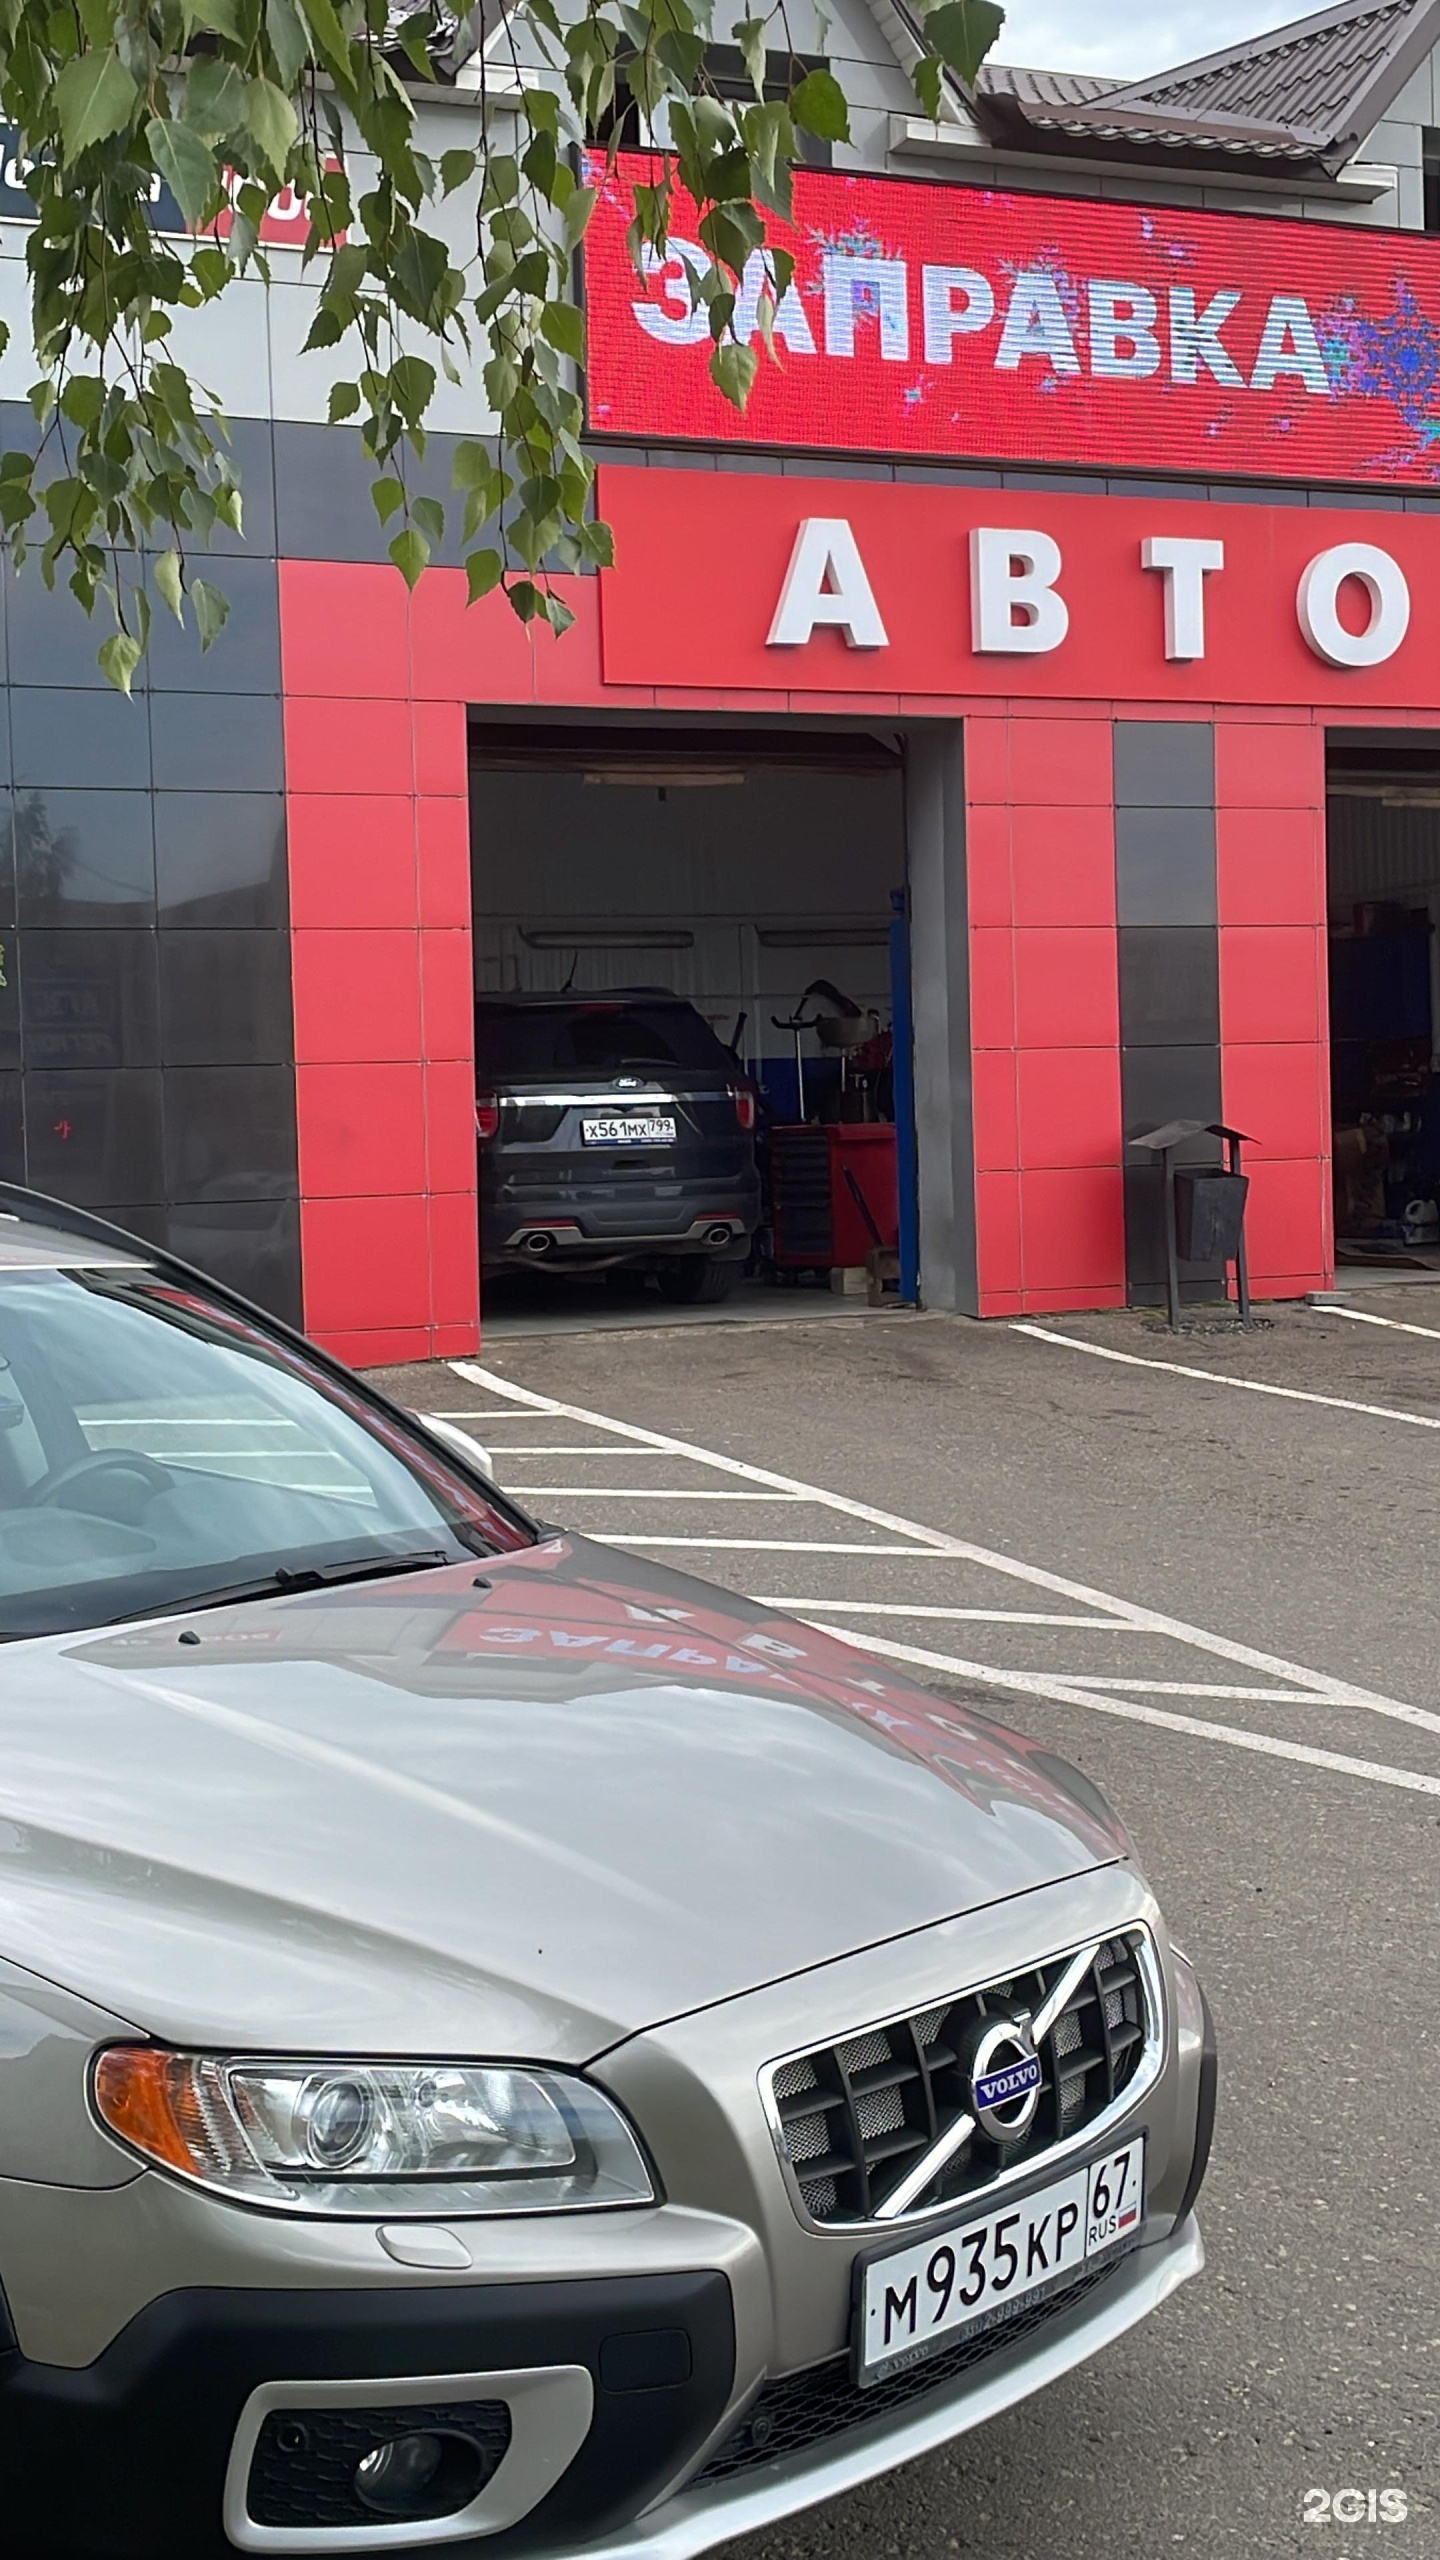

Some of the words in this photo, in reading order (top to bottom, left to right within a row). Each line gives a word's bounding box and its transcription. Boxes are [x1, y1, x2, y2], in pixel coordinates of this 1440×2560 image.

[631, 236, 1332, 395] ЗАПРАВКА
[765, 517, 1411, 669] АВТО
[980, 2063, 1038, 2100] VOLVO
[883, 2201, 1079, 2346] М935КР
[1090, 2150, 1132, 2220] 67
[1087, 2214, 1117, 2247] RUS
